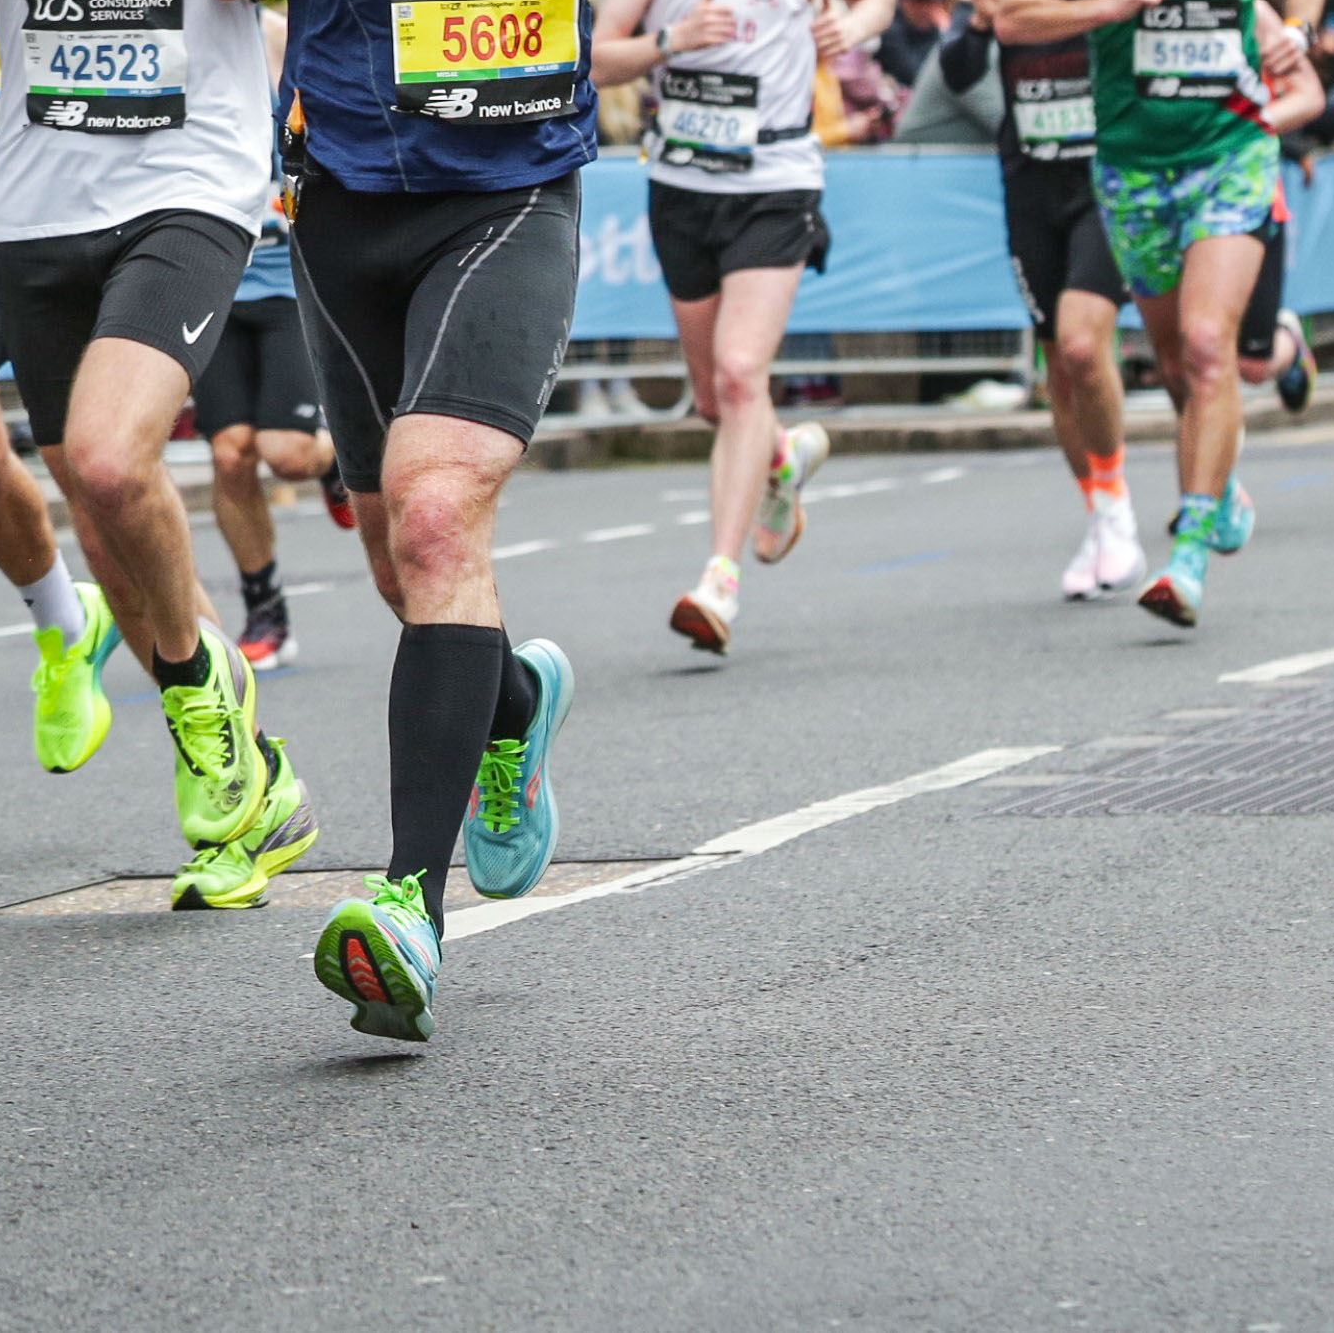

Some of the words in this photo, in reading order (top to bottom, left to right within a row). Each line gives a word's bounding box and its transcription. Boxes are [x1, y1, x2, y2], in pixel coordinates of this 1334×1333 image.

[90, 10, 145, 21] SERVICES
[443, 11, 543, 62] 5608
[50, 43, 160, 82] 42523
[479, 104, 512, 117] new
[514, 97, 561, 115] balance
[87, 117, 116, 127] new
[117, 115, 171, 128] balance
